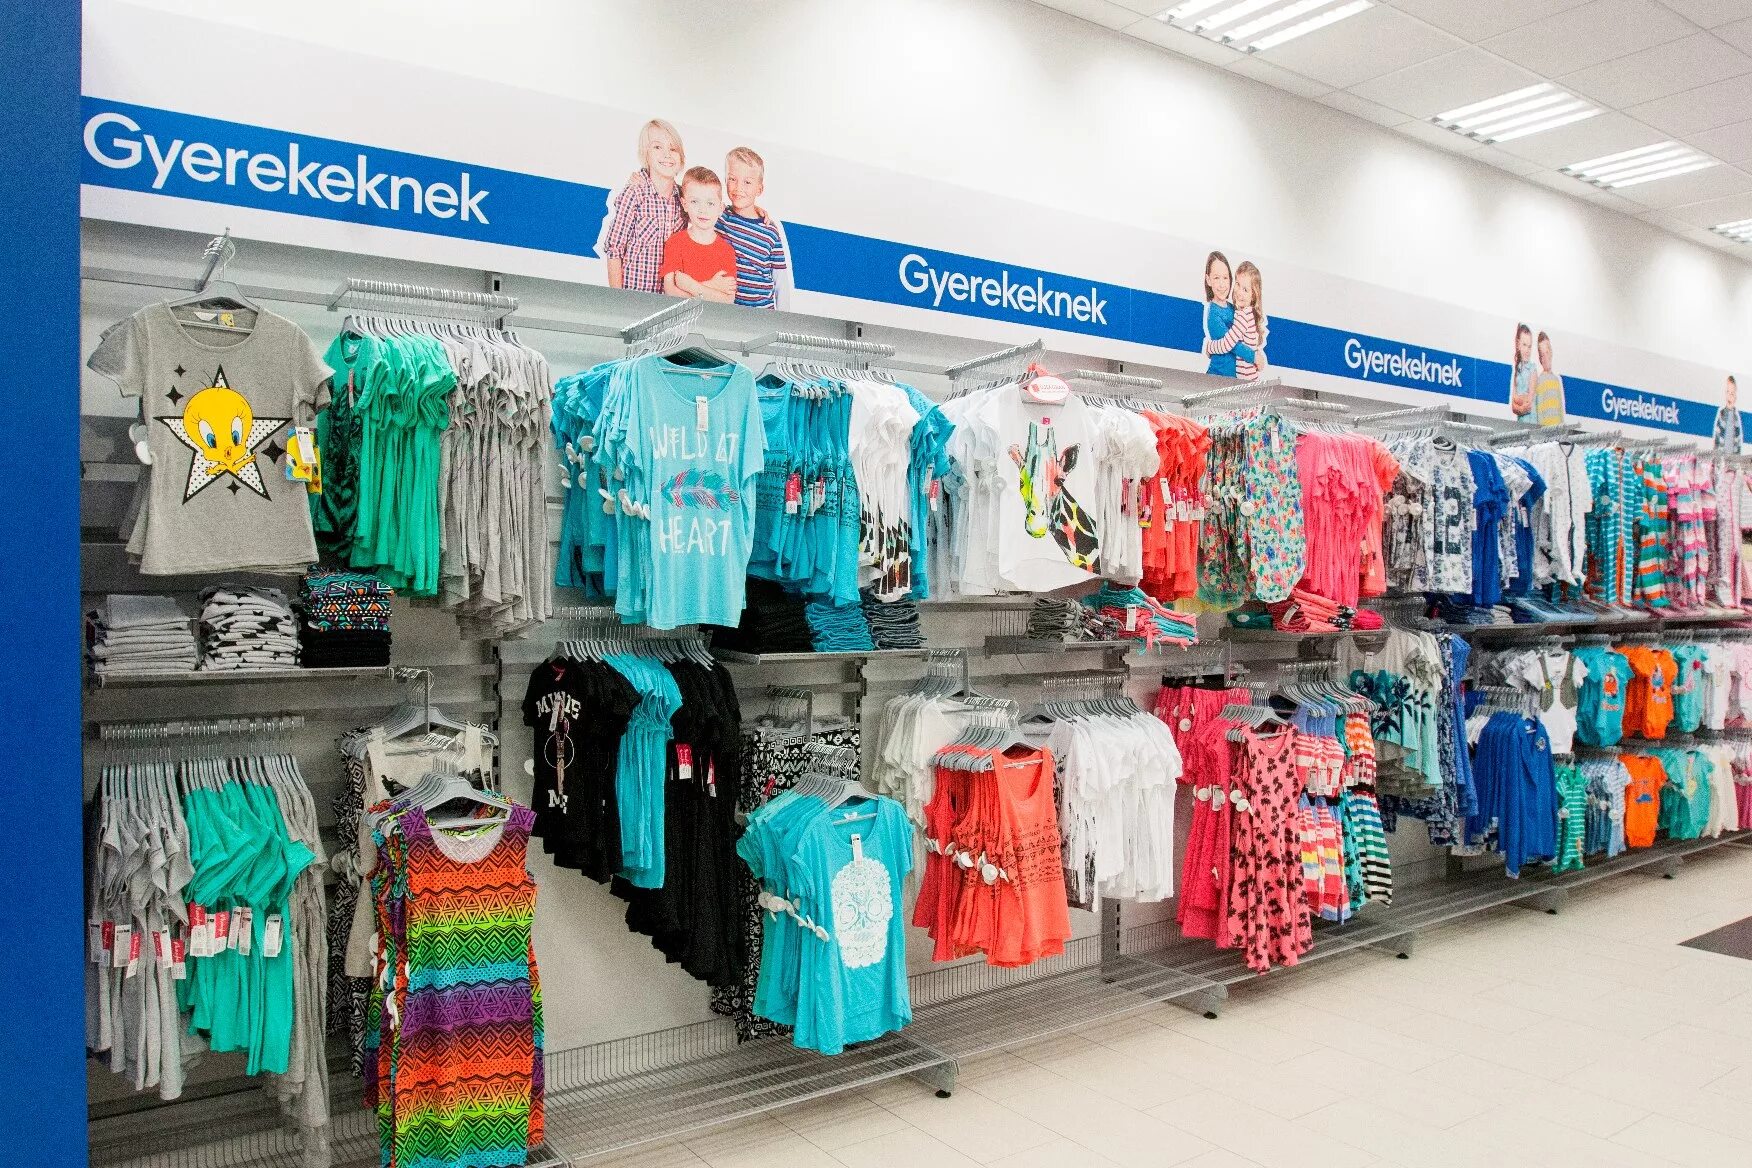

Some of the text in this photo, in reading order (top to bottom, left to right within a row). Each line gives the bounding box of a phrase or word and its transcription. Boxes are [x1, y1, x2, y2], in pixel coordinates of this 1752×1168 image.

[83, 112, 490, 225] Gyerekeknek
[899, 254, 1108, 325] Gyerekeknek
[1344, 338, 1462, 387] Gyerekeknek
[1602, 388, 1679, 425] Gyerekeknek
[659, 515, 733, 557] HEART
